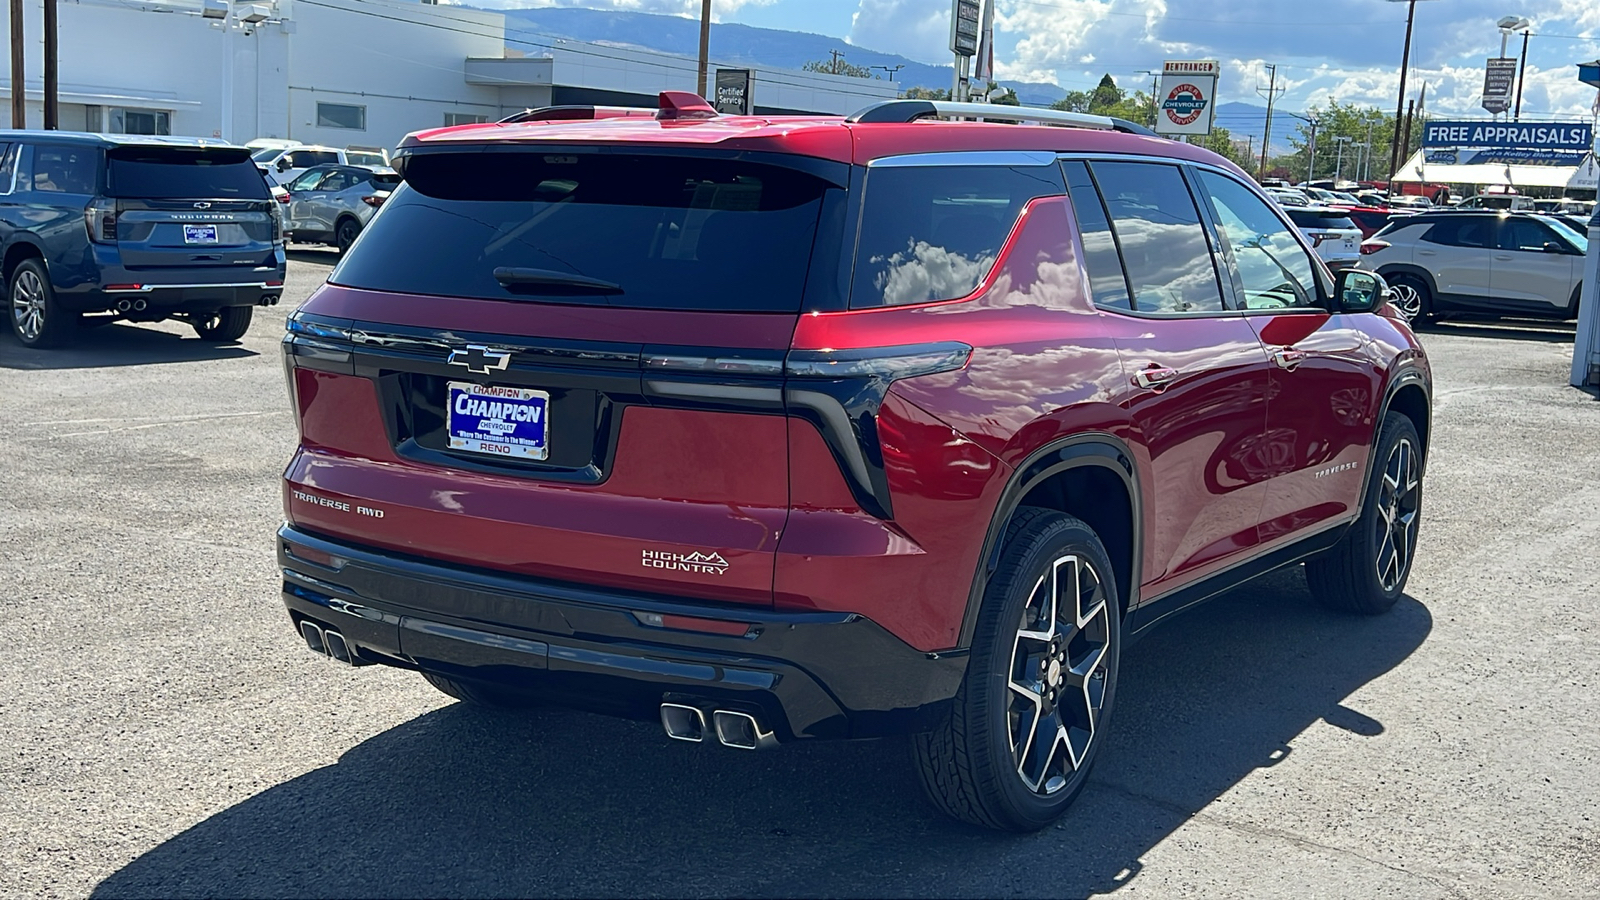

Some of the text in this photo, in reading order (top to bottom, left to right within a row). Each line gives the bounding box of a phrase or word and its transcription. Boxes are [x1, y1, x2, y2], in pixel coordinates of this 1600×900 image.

[1169, 63, 1208, 71] ENTRANCE
[718, 87, 744, 96] Certified
[1173, 85, 1199, 96] SUPER
[719, 96, 742, 105] Service
[1168, 111, 1199, 124] SERVICE
[1428, 127, 1586, 144] FREE APPRAISALS!
[473, 386, 520, 398] CHAMPION
[455, 394, 541, 423] CHAMPION
[480, 422, 513, 432] CHEVROLET
[480, 442, 510, 454] RENO
[1315, 462, 1358, 478] TRAVERSE
[294, 490, 384, 518] TRAVERSE AWD
[642, 549, 684, 562] HIGH
[642, 558, 728, 575] COUNTRY
